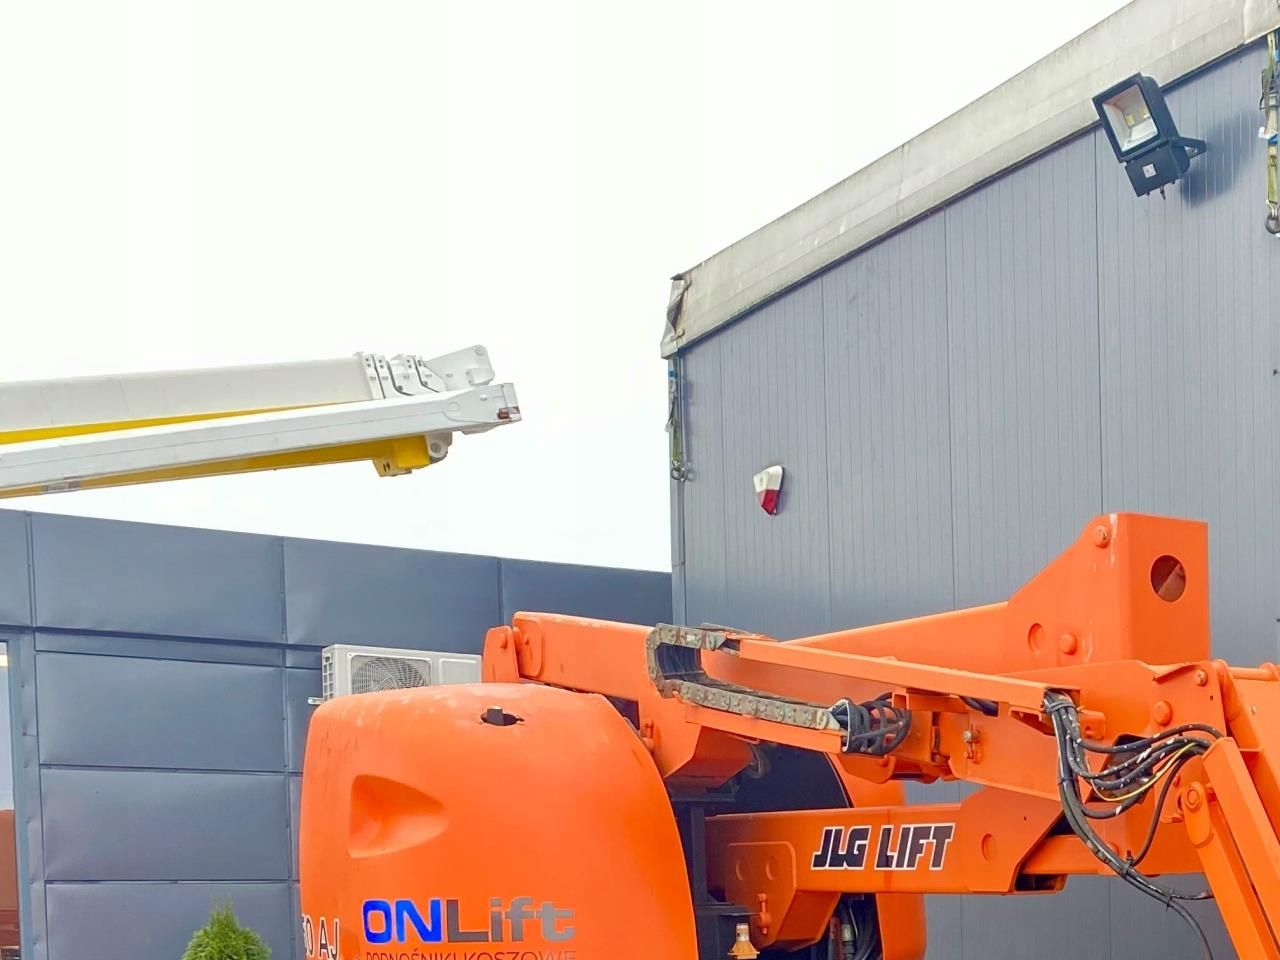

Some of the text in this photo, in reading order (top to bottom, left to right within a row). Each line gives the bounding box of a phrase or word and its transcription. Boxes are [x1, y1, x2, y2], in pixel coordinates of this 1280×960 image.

[811, 823, 956, 870] JLG LIFT
[362, 896, 576, 944] ONLift
